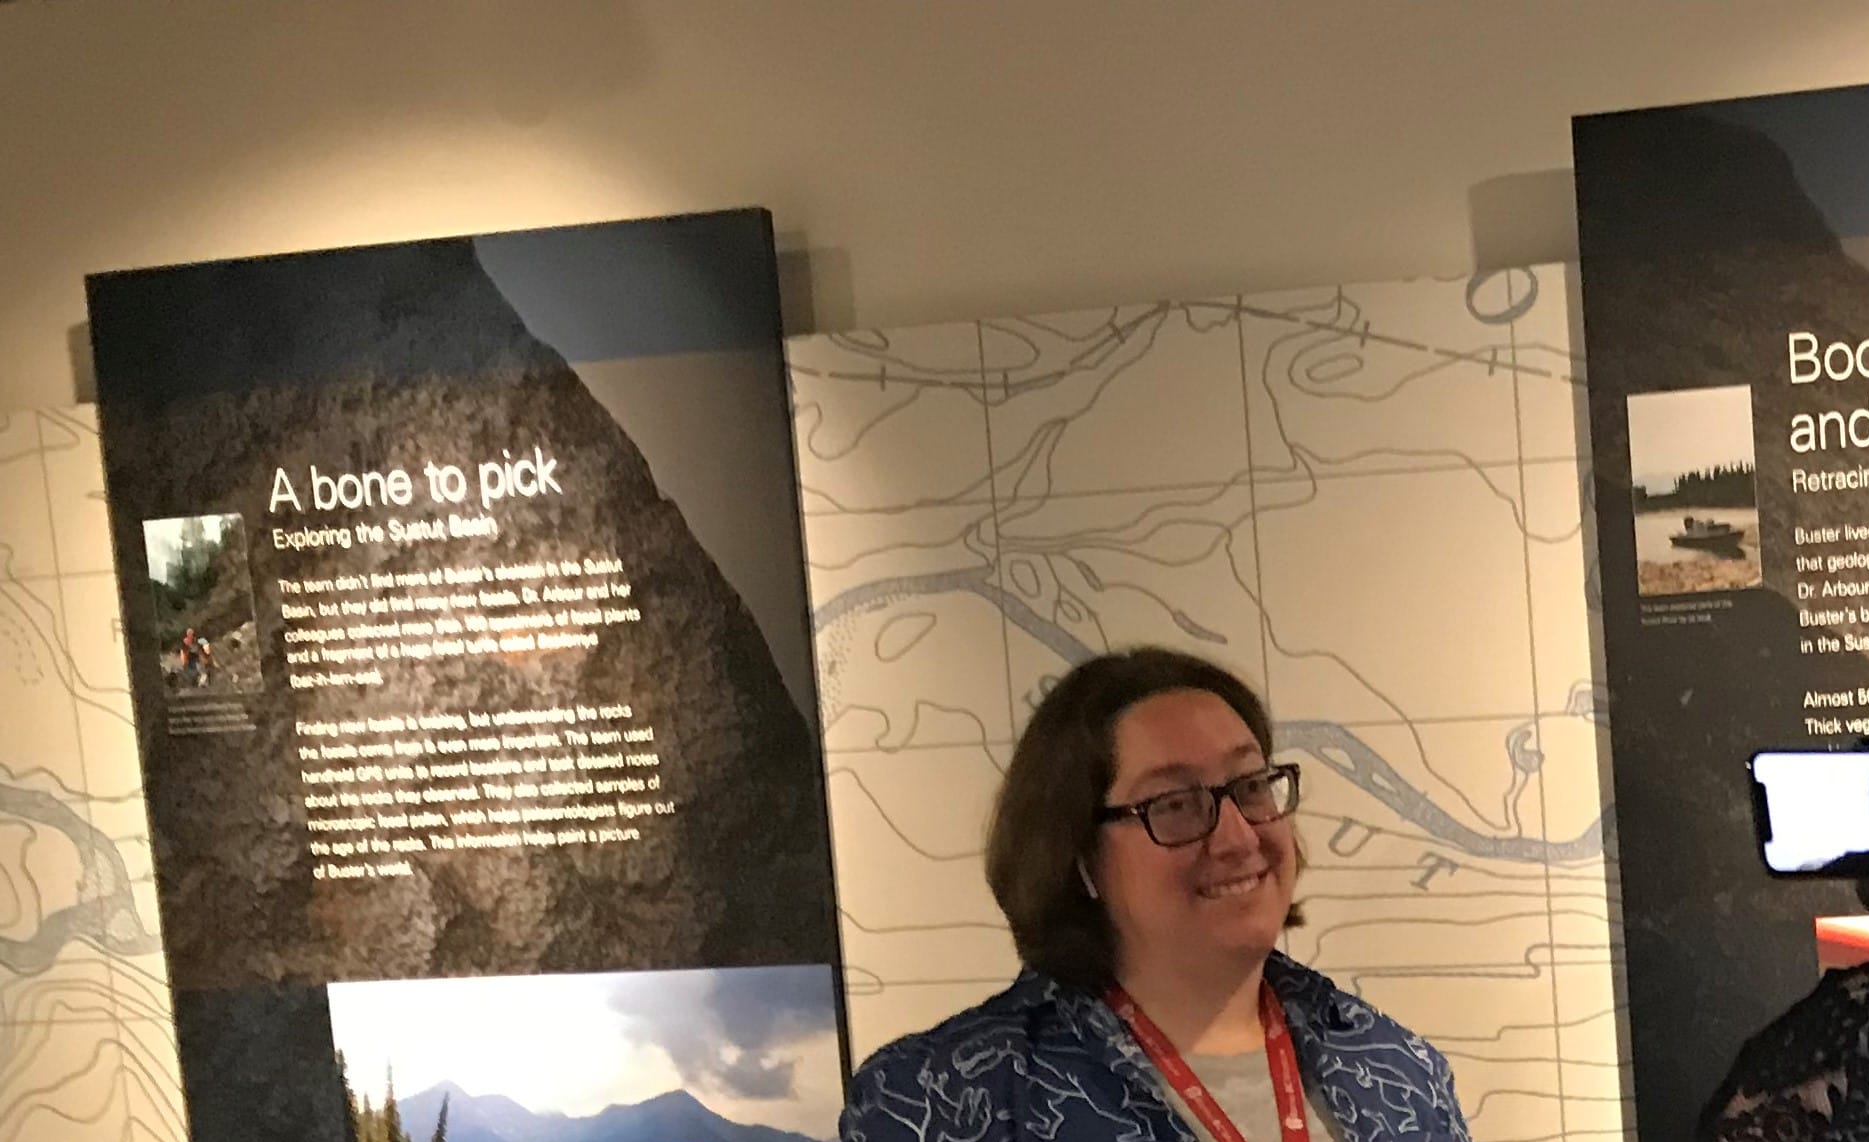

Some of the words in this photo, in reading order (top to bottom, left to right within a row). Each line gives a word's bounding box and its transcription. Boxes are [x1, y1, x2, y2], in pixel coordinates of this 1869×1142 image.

[269, 467, 302, 513] A
[310, 465, 413, 511] bone
[423, 460, 467, 502] to
[478, 445, 563, 510] pick
[273, 526, 351, 551] Exploring
[356, 521, 384, 543] the
[1794, 527, 1841, 545] Buster
[1796, 556, 1823, 572] that
[1822, 580, 1869, 598] Arbour
[1799, 606, 1857, 627] Buster's
[1800, 640, 1813, 653] in
[1817, 636, 1840, 653] the
[1803, 690, 1854, 708] Almost
[1804, 716, 1842, 735] Thick
[654, 801, 675, 815] out
